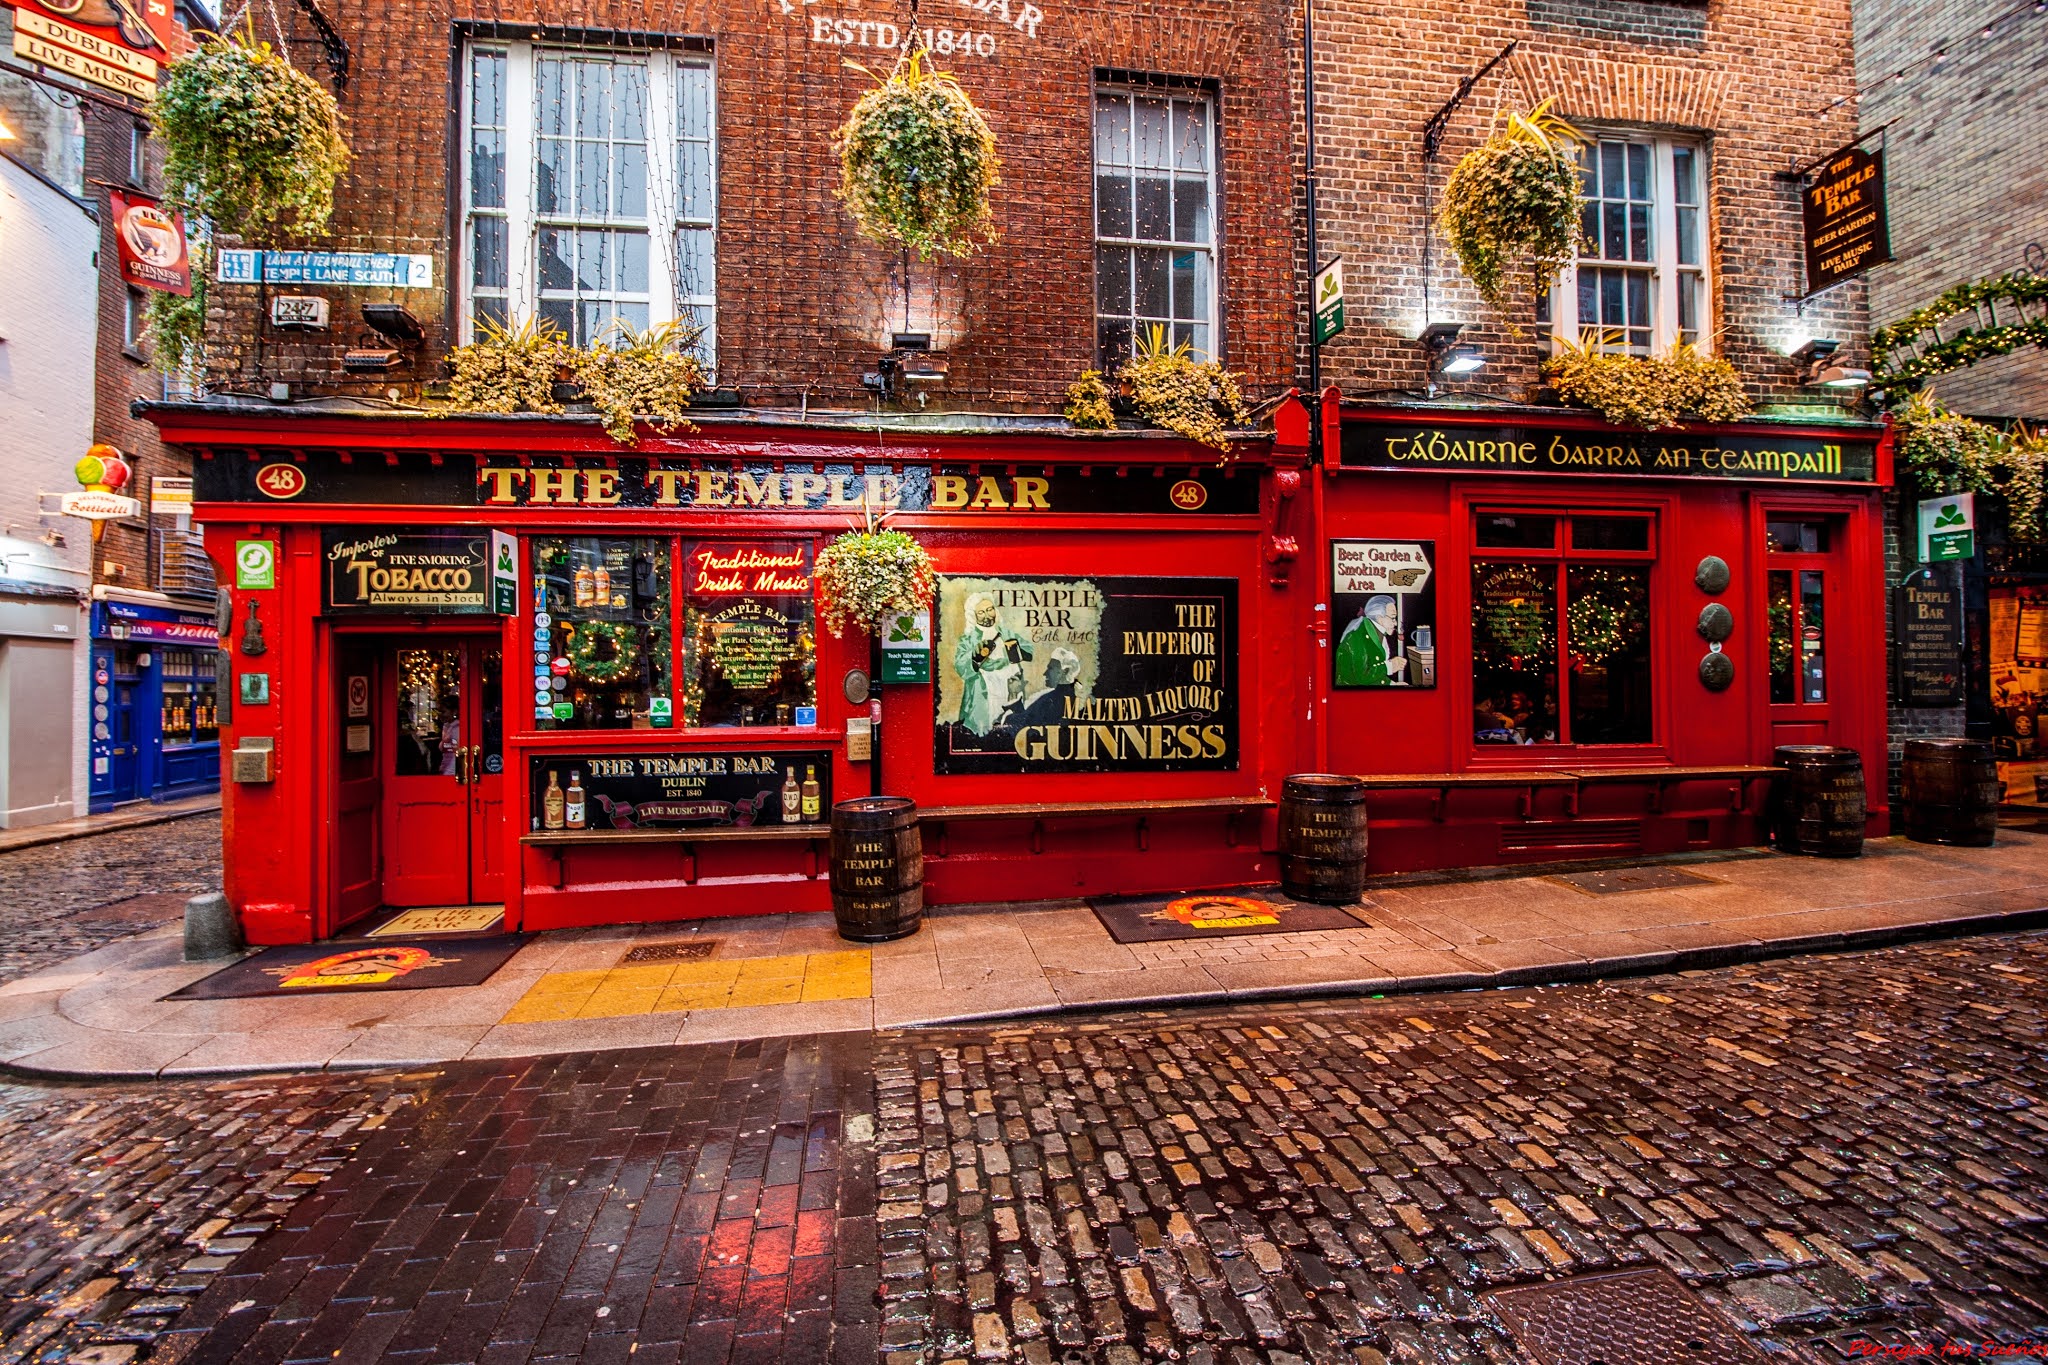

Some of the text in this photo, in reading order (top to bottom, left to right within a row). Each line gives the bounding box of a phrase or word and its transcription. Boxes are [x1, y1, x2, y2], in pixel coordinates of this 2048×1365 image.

[47, 23, 129, 64] DUBLIN
[923, 28, 995, 57] 1840
[29, 42, 145, 94] LIVE MUSIC
[1830, 155, 1854, 175] THE
[1811, 164, 1875, 207] TEMPLE
[1825, 189, 1861, 217] BAR
[1813, 211, 1877, 248] BEER GARDEN
[1820, 241, 1873, 271] LIVE MUSIC
[1833, 256, 1861, 274] DAILY
[130, 261, 181, 280] GUINNESS
[264, 267, 399, 282] TEMPLE LANE SOUTH
[415, 264, 426, 278] 2
[265, 469, 295, 490] 48
[481, 467, 1051, 511] THE TEMPLE BAR
[1175, 485, 1199, 503] 48
[68, 501, 129, 514] Botticelli
[327, 533, 398, 561] Importers
[371, 549, 385, 558] OF
[1337, 547, 1424, 563] Beer Garden &
[390, 555, 471, 566] FINE SMOKING
[697, 548, 804, 571] Traditional
[346, 560, 472, 600] TOBACCO
[1337, 563, 1387, 579] Smoking
[694, 571, 809, 591] Irish Music
[1347, 578, 1375, 590] Area
[1525, 573, 1544, 590] BAR
[373, 592, 482, 604] Always in Stock
[992, 589, 1098, 609] TEMPLE
[1906, 586, 1951, 603] TEMPLE
[711, 604, 789, 626] TEMPLE BAR
[1024, 609, 1074, 630] BAR
[1175, 604, 1216, 628] THE
[1918, 603, 1945, 619] BAR
[1066, 630, 1094, 645] 1840
[1122, 631, 1216, 656] EMPEROR
[1193, 659, 1216, 683] OF
[1062, 685, 1224, 722] MALTED LIQUORS
[1014, 724, 1227, 761] GUINNESS
[588, 757, 778, 777] THE TEMPLE BAR
[661, 777, 707, 788] DUBLIN
[666, 789, 702, 797] EST. 1840
[641, 806, 728, 816] LIVE MUSIC DAILY
[1300, 827, 1353, 838] TEMPLE
[854, 842, 883, 853] THE
[842, 857, 897, 870] TEMPLE
[855, 876, 884, 887] BAR
[870, 902, 891, 910] 1840
